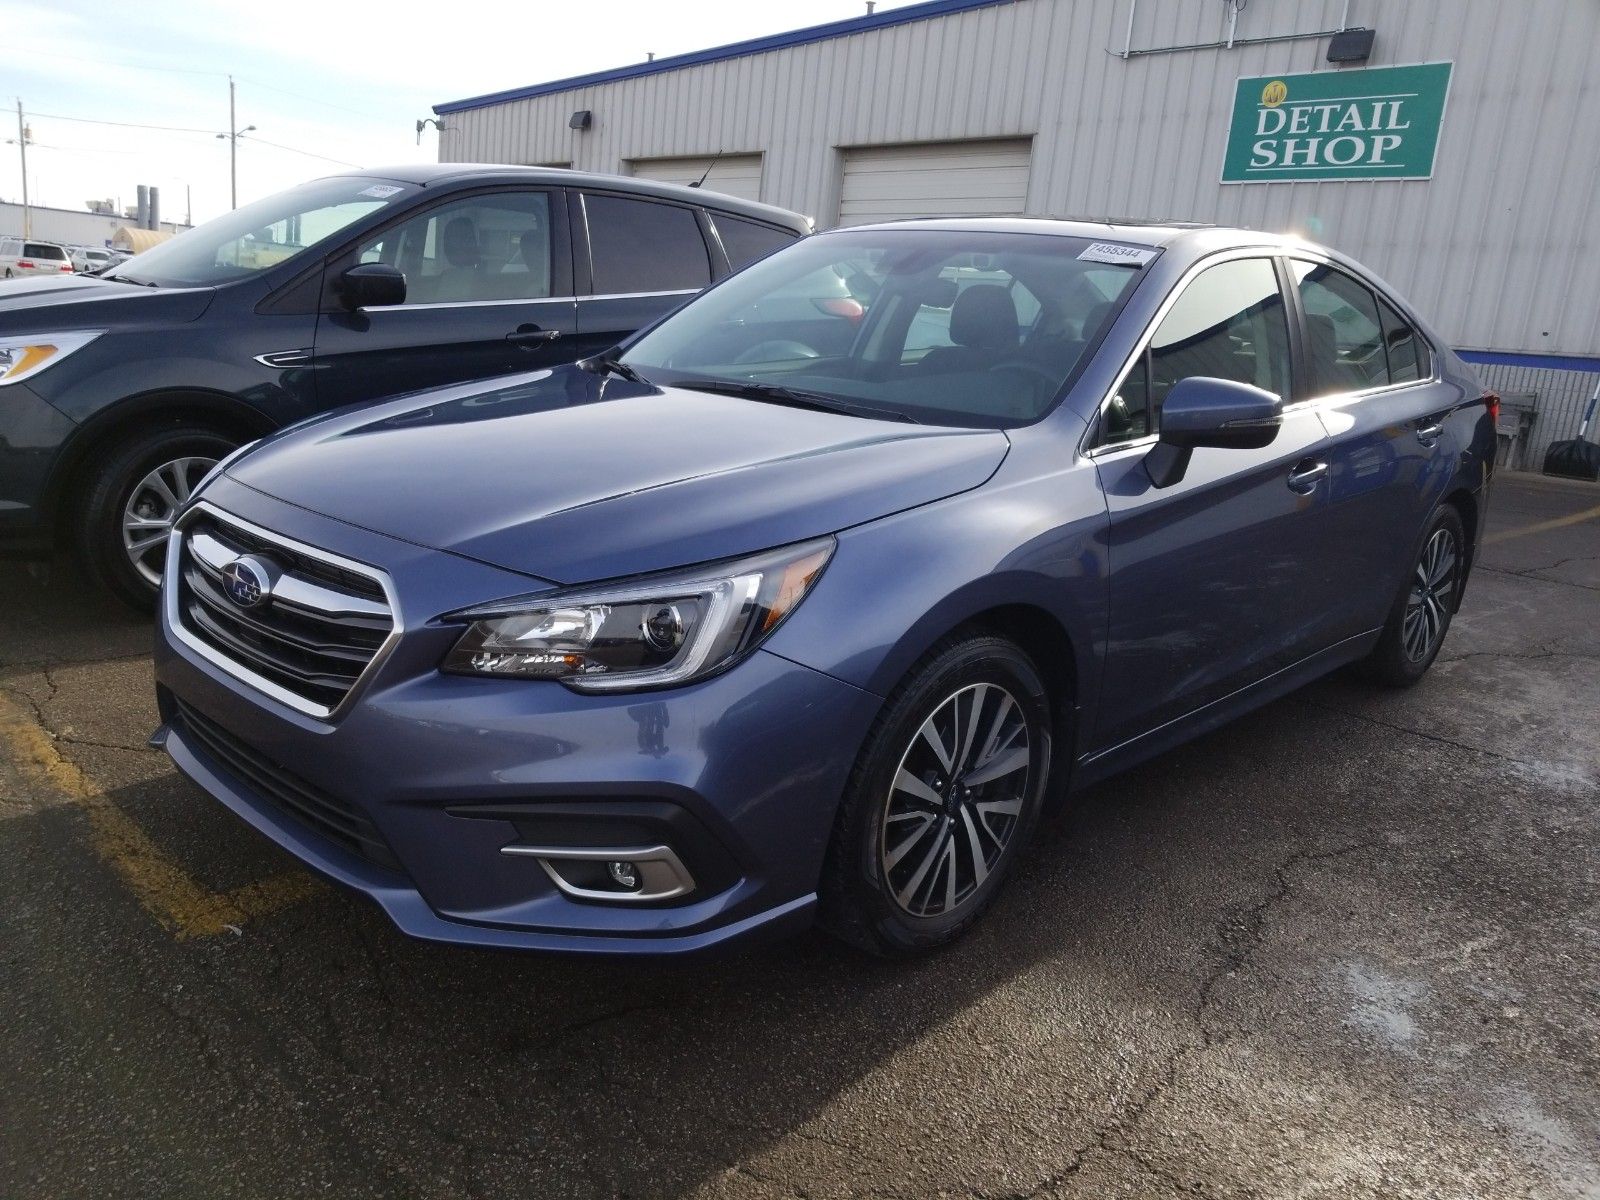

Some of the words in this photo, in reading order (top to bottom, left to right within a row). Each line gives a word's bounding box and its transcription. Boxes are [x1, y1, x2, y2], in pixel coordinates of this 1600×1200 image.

[1255, 101, 1410, 135] DETAIL
[1250, 135, 1402, 167] SHOP
[1089, 243, 1141, 257] 7455344
